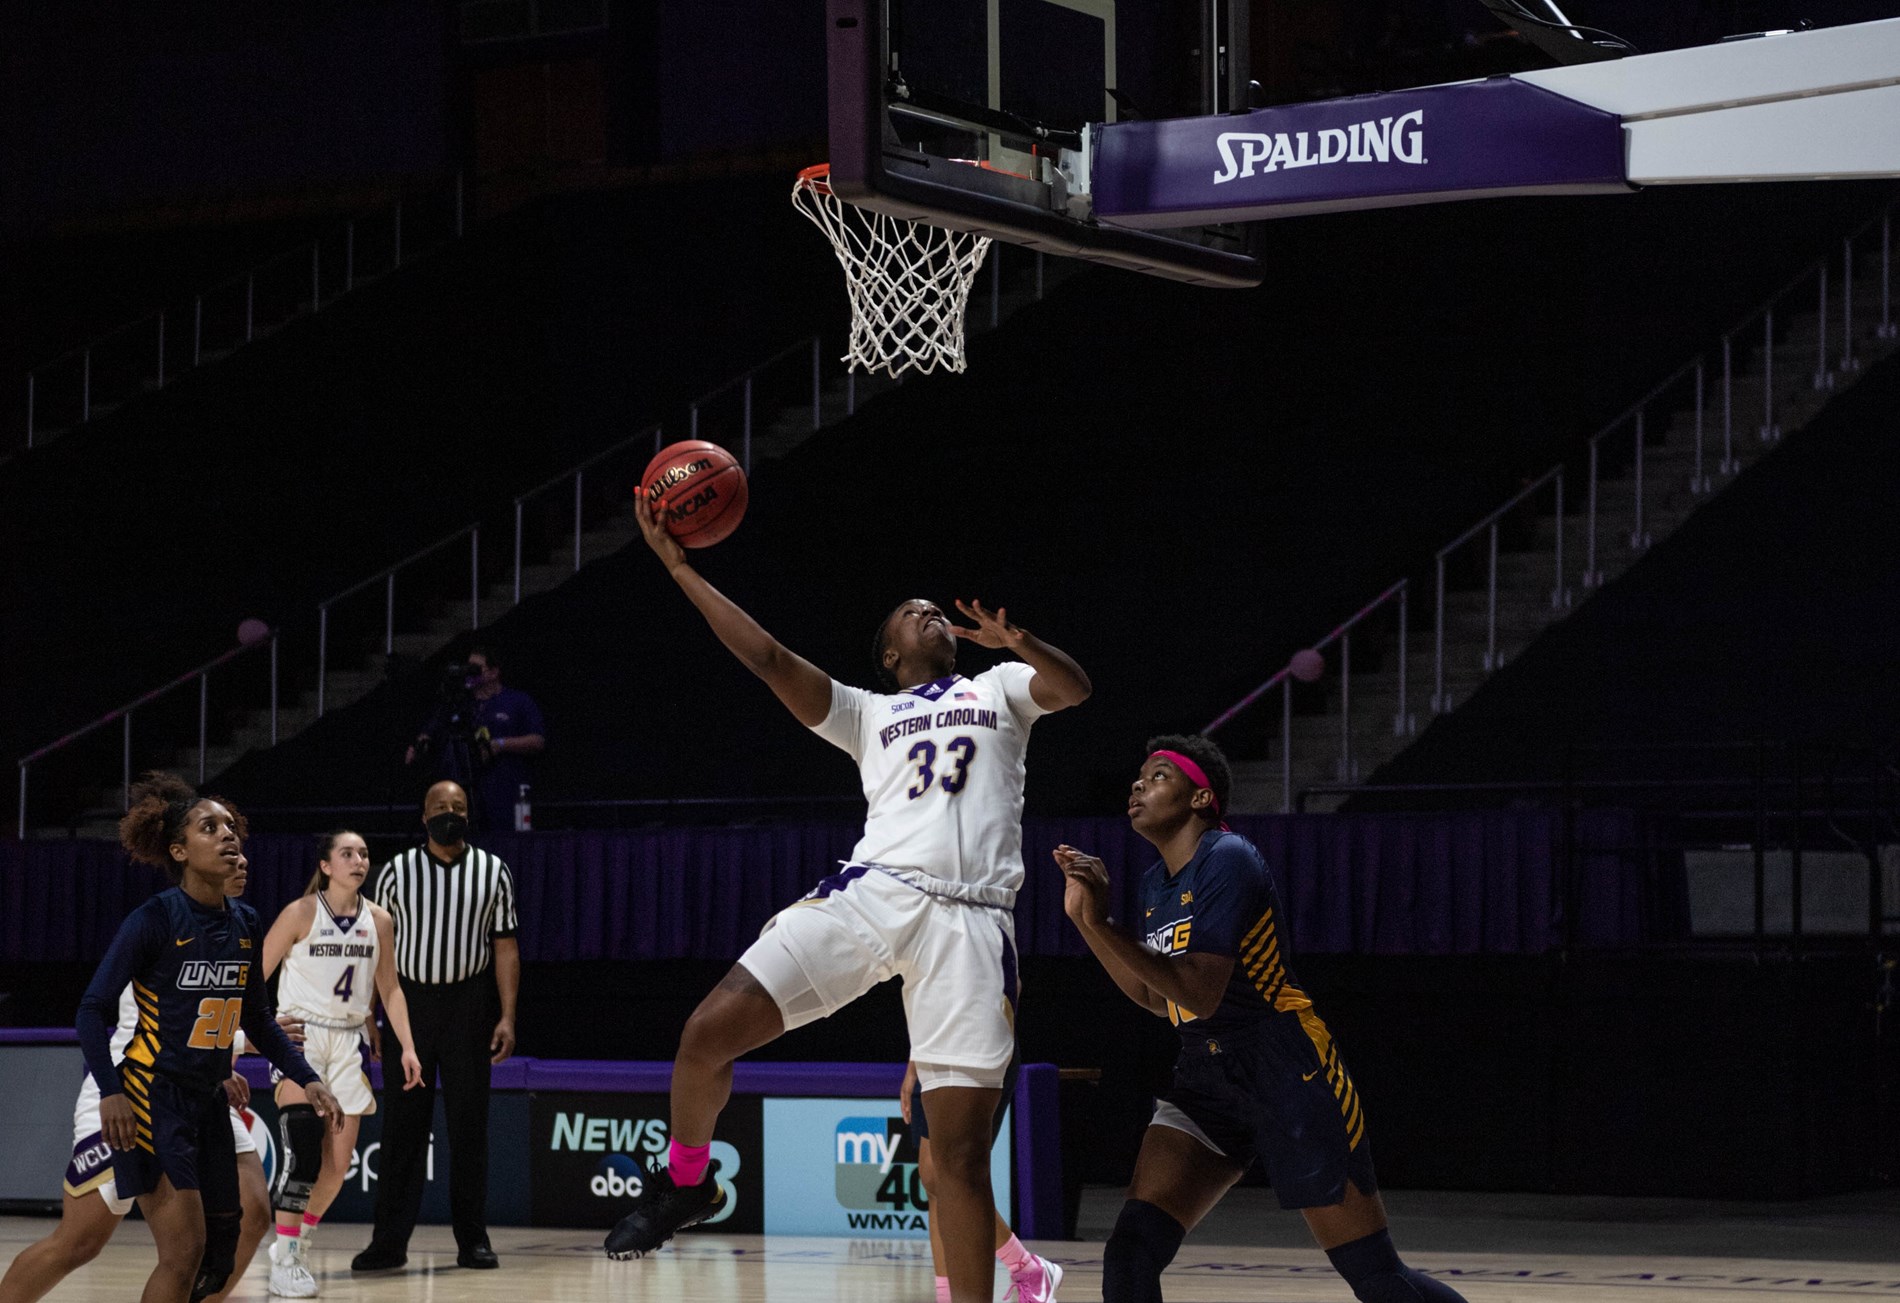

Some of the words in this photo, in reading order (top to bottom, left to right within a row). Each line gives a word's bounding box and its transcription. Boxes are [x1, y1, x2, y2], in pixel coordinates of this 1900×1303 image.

[1213, 109, 1424, 184] SPALDING
[649, 458, 714, 502] Wilson
[666, 486, 717, 521] NCAA
[879, 713, 932, 750] WESTERN
[936, 708, 998, 731] CAROLINA
[908, 736, 976, 800] 33
[309, 943, 343, 957] WESTERN
[177, 961, 252, 990] UNCG
[333, 964, 355, 1003] 4
[186, 997, 243, 1050] 20
[551, 1112, 668, 1154] NEWS
[836, 1131, 902, 1174] my
[72, 1141, 112, 1175] WCU
[590, 1166, 643, 1198] abc
[848, 1213, 928, 1231] WMYA
